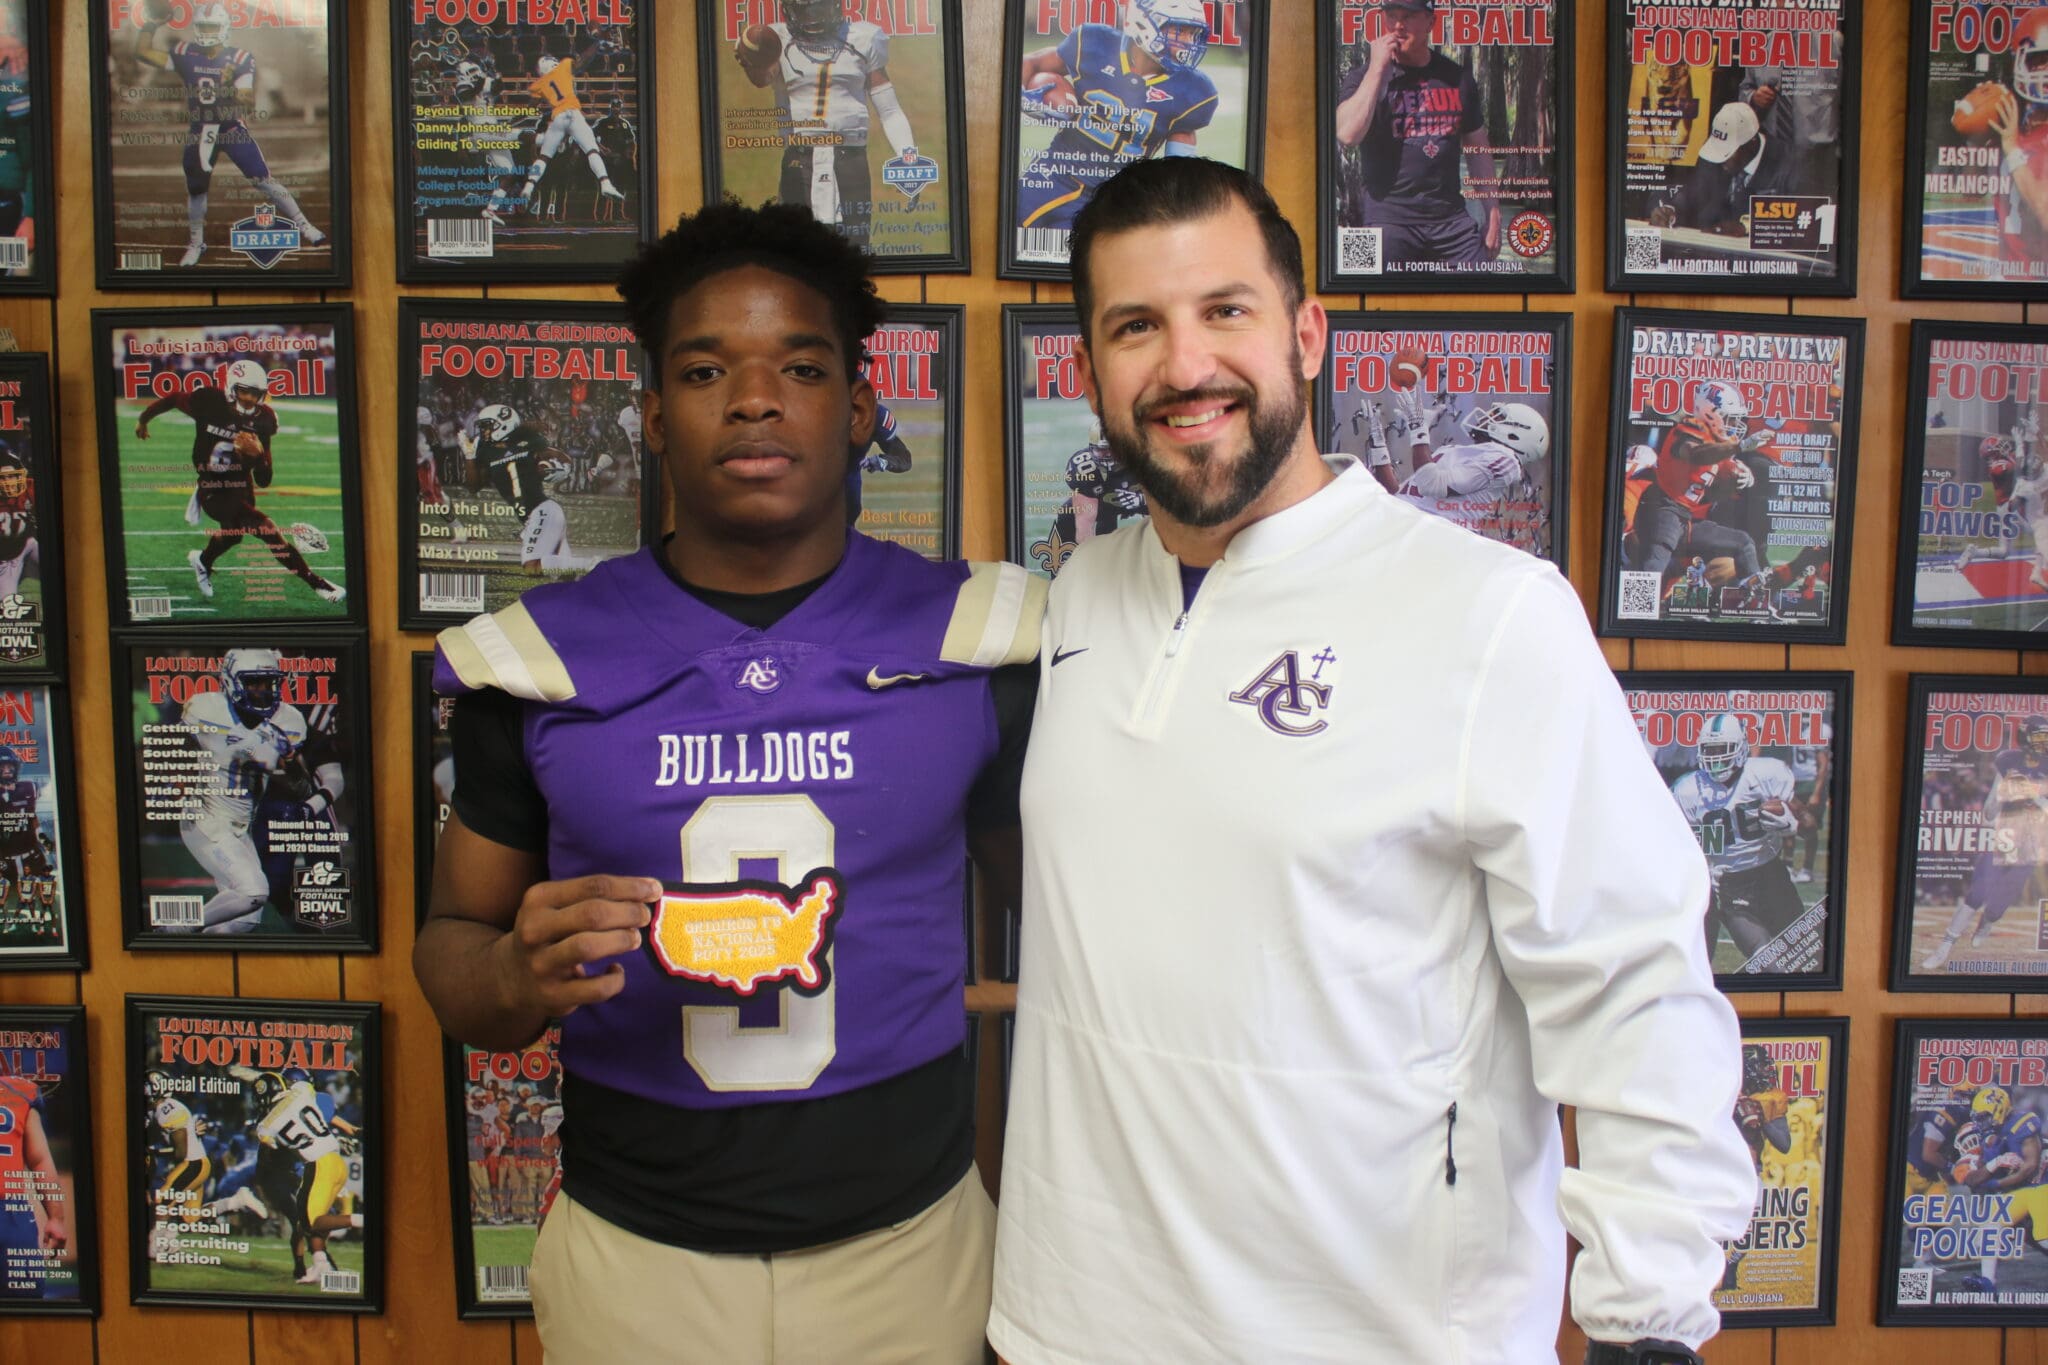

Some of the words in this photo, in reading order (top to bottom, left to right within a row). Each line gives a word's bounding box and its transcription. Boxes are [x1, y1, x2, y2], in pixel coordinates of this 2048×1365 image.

[1635, 6, 1739, 29] LOUISIANA
[1741, 9, 1838, 31] GRIDIRON
[1632, 28, 1838, 68] FOOTBALL
[416, 105, 460, 117] Beyond
[463, 105, 484, 115] The
[487, 105, 540, 116] Endzone:
[725, 108, 768, 119] Interview
[1048, 103, 1097, 115] Lenard
[1102, 105, 1144, 118] Tillery
[416, 123, 451, 136] Danny
[455, 123, 512, 134] Johnson's
[1023, 118, 1080, 130] Southern
[1083, 120, 1147, 134] University
[416, 139, 458, 152] Gliding
[460, 139, 474, 149] To
[477, 139, 520, 150] Success
[726, 135, 784, 148] Devante
[788, 132, 844, 146] Kincade
[1053, 151, 1087, 162] made
[1090, 152, 1110, 162] the
[1938, 147, 1999, 167] EASTON
[418, 165, 459, 178] Midway
[461, 166, 486, 176] Look
[887, 168, 935, 180] DRAFT
[1627, 164, 1665, 172] Recruiting
[417, 180, 456, 192] College
[457, 180, 500, 190] Football
[1021, 178, 1054, 189] Team
[1463, 177, 1501, 187] University
[1502, 177, 1511, 186] of
[1512, 178, 1549, 186] Louisiana
[1925, 174, 2011, 195] MELANCON
[1490, 191, 1519, 201] Making
[1527, 191, 1553, 201] Splash
[857, 202, 873, 214] 32
[1755, 202, 1797, 219] LSU
[236, 233, 295, 247] DRAFT
[1386, 262, 1403, 272] ALL
[1456, 262, 1473, 272] ALL
[1475, 262, 1523, 273] LOUISIANA
[1667, 259, 1683, 273] ALL
[1684, 259, 1732, 274] FOOTBALL,
[1733, 260, 1748, 274] ALL
[1750, 260, 1798, 275] LOUISIANA
[420, 322, 530, 340] LOUISIANA
[536, 325, 636, 343] GRIDIRON
[129, 337, 228, 355] Louisiana
[234, 335, 318, 352] Gridiron
[1335, 331, 1443, 355] LOUISIANA
[1449, 333, 1552, 356] GRIDIRON
[1632, 330, 1718, 357] DRAFT
[1721, 333, 1839, 362] PREVIEW
[1931, 340, 2036, 363] LOUISIANA
[420, 344, 638, 381] FOOTBALL
[1634, 356, 1736, 379] LOUISIANA
[1739, 360, 1833, 384] GRIDIRON
[1776, 433, 1803, 446] MOCK
[1804, 434, 1832, 447] DRAFT
[1075, 471, 1096, 483] the
[1931, 470, 1951, 478] Tech
[1778, 484, 1792, 496] ALL
[1794, 485, 1805, 497] 32
[1806, 485, 1821, 497] NFL
[1922, 482, 1983, 508] TOP
[420, 502, 450, 515] Into
[454, 502, 480, 515] the
[484, 502, 527, 517] Lion's
[1028, 504, 1048, 515] the
[1436, 500, 1460, 511] Can
[1768, 500, 1790, 512] TEAM
[1792, 501, 1831, 514] REPORTS
[862, 510, 894, 524] Best
[898, 511, 936, 526] Kept
[1771, 517, 1825, 531] LOUISIANA
[419, 523, 450, 537] Den
[454, 524, 488, 538] with
[1919, 512, 2019, 540] DAWGS
[1767, 533, 1829, 547] HIGHLIGHTS
[420, 546, 451, 559] Max
[454, 547, 499, 561] Lyons
[738, 660, 780, 693] AC
[1228, 649, 1333, 737] AC
[1627, 692, 1729, 710] LOUISIANA
[1732, 692, 1827, 711] GRIDIRON
[143, 724, 199, 735] Getting
[203, 725, 219, 734] to
[143, 737, 185, 746] Know
[143, 749, 213, 760] Southern
[655, 731, 854, 787] BULLDOGS
[144, 762, 220, 773] University
[144, 774, 220, 783] Freshman
[145, 786, 181, 796] Wide
[184, 786, 249, 796] Receiver
[145, 799, 202, 808] Kendall
[146, 811, 205, 821] Catalon
[1920, 810, 1982, 825] STEPHEN
[268, 820, 303, 830] Diamond
[305, 820, 315, 830] In
[316, 820, 331, 830] The
[269, 832, 299, 843] Roughs
[301, 832, 313, 842] For
[314, 832, 327, 842] the
[329, 832, 349, 842] 2019
[1918, 827, 2015, 853] RIVERS
[269, 844, 284, 853] and
[308, 844, 340, 853] Classes
[302, 871, 342, 886] LGF
[300, 892, 343, 901] FOOTBALL
[300, 901, 346, 914] BOWL
[684, 917, 757, 934] GRIDIRON
[761, 915, 783, 929] FB
[692, 930, 777, 948] NATIONAL
[1746, 938, 1788, 975] SPRING
[1784, 904, 1828, 945] UPDATE
[738, 943, 777, 959] 2025
[1948, 960, 1963, 973] ALL
[2011, 961, 2025, 974] ALL
[158, 1017, 257, 1037] LOUISIANA
[261, 1022, 354, 1041] GRIDIRON
[160, 1035, 355, 1071] FOOTBALL
[1920, 1039, 2018, 1057] LOUISIANA
[152, 1075, 197, 1095] Special
[199, 1076, 241, 1095] Edition
[277, 1105, 332, 1150] 50
[4, 1170, 46, 1179] GARRETT
[4, 1181, 61, 1191] BRUMFIELD,
[5, 1193, 31, 1201] PATH
[33, 1193, 47, 1201] TO
[48, 1193, 65, 1201] THE
[155, 1189, 198, 1202] High
[5, 1204, 35, 1212] DRAFT
[155, 1204, 218, 1218] School
[1903, 1194, 2014, 1226] GEAUX
[155, 1221, 231, 1236] Football
[155, 1237, 249, 1254] Recruiting
[1914, 1227, 2025, 1260] POKES!
[7, 1248, 55, 1257] DIAMONDS
[57, 1248, 67, 1256] IN
[156, 1253, 221, 1266] Edition
[8, 1259, 26, 1267] THE
[29, 1259, 61, 1268] ROUGH
[8, 1270, 27, 1279] FOR
[29, 1270, 46, 1279] THE
[49, 1270, 72, 1279] 2020
[8, 1281, 37, 1290] CLASS
[1721, 1293, 1736, 1304] ALL
[1739, 1293, 1784, 1304] LOUISIANA
[1935, 1292, 1950, 1305] ALL
[1998, 1292, 2014, 1306] ALL
